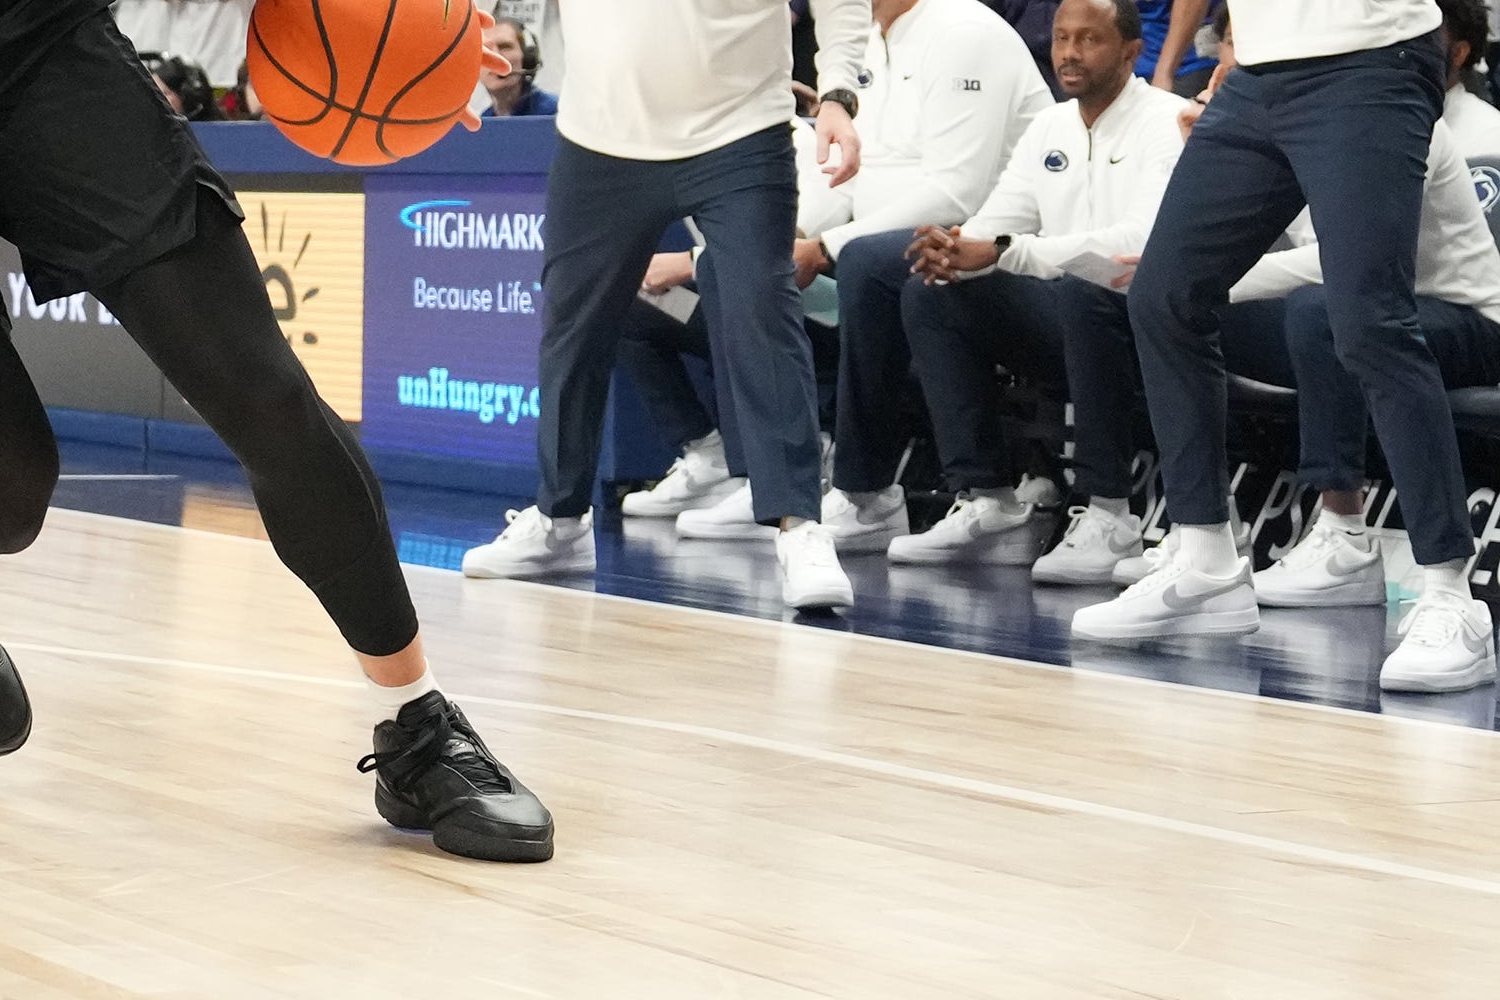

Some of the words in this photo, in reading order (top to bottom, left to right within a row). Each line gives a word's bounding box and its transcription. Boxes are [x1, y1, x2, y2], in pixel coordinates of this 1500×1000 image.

[413, 211, 546, 251] HIGHMARK
[413, 276, 493, 313] Because
[397, 367, 541, 425] unHungry.c
